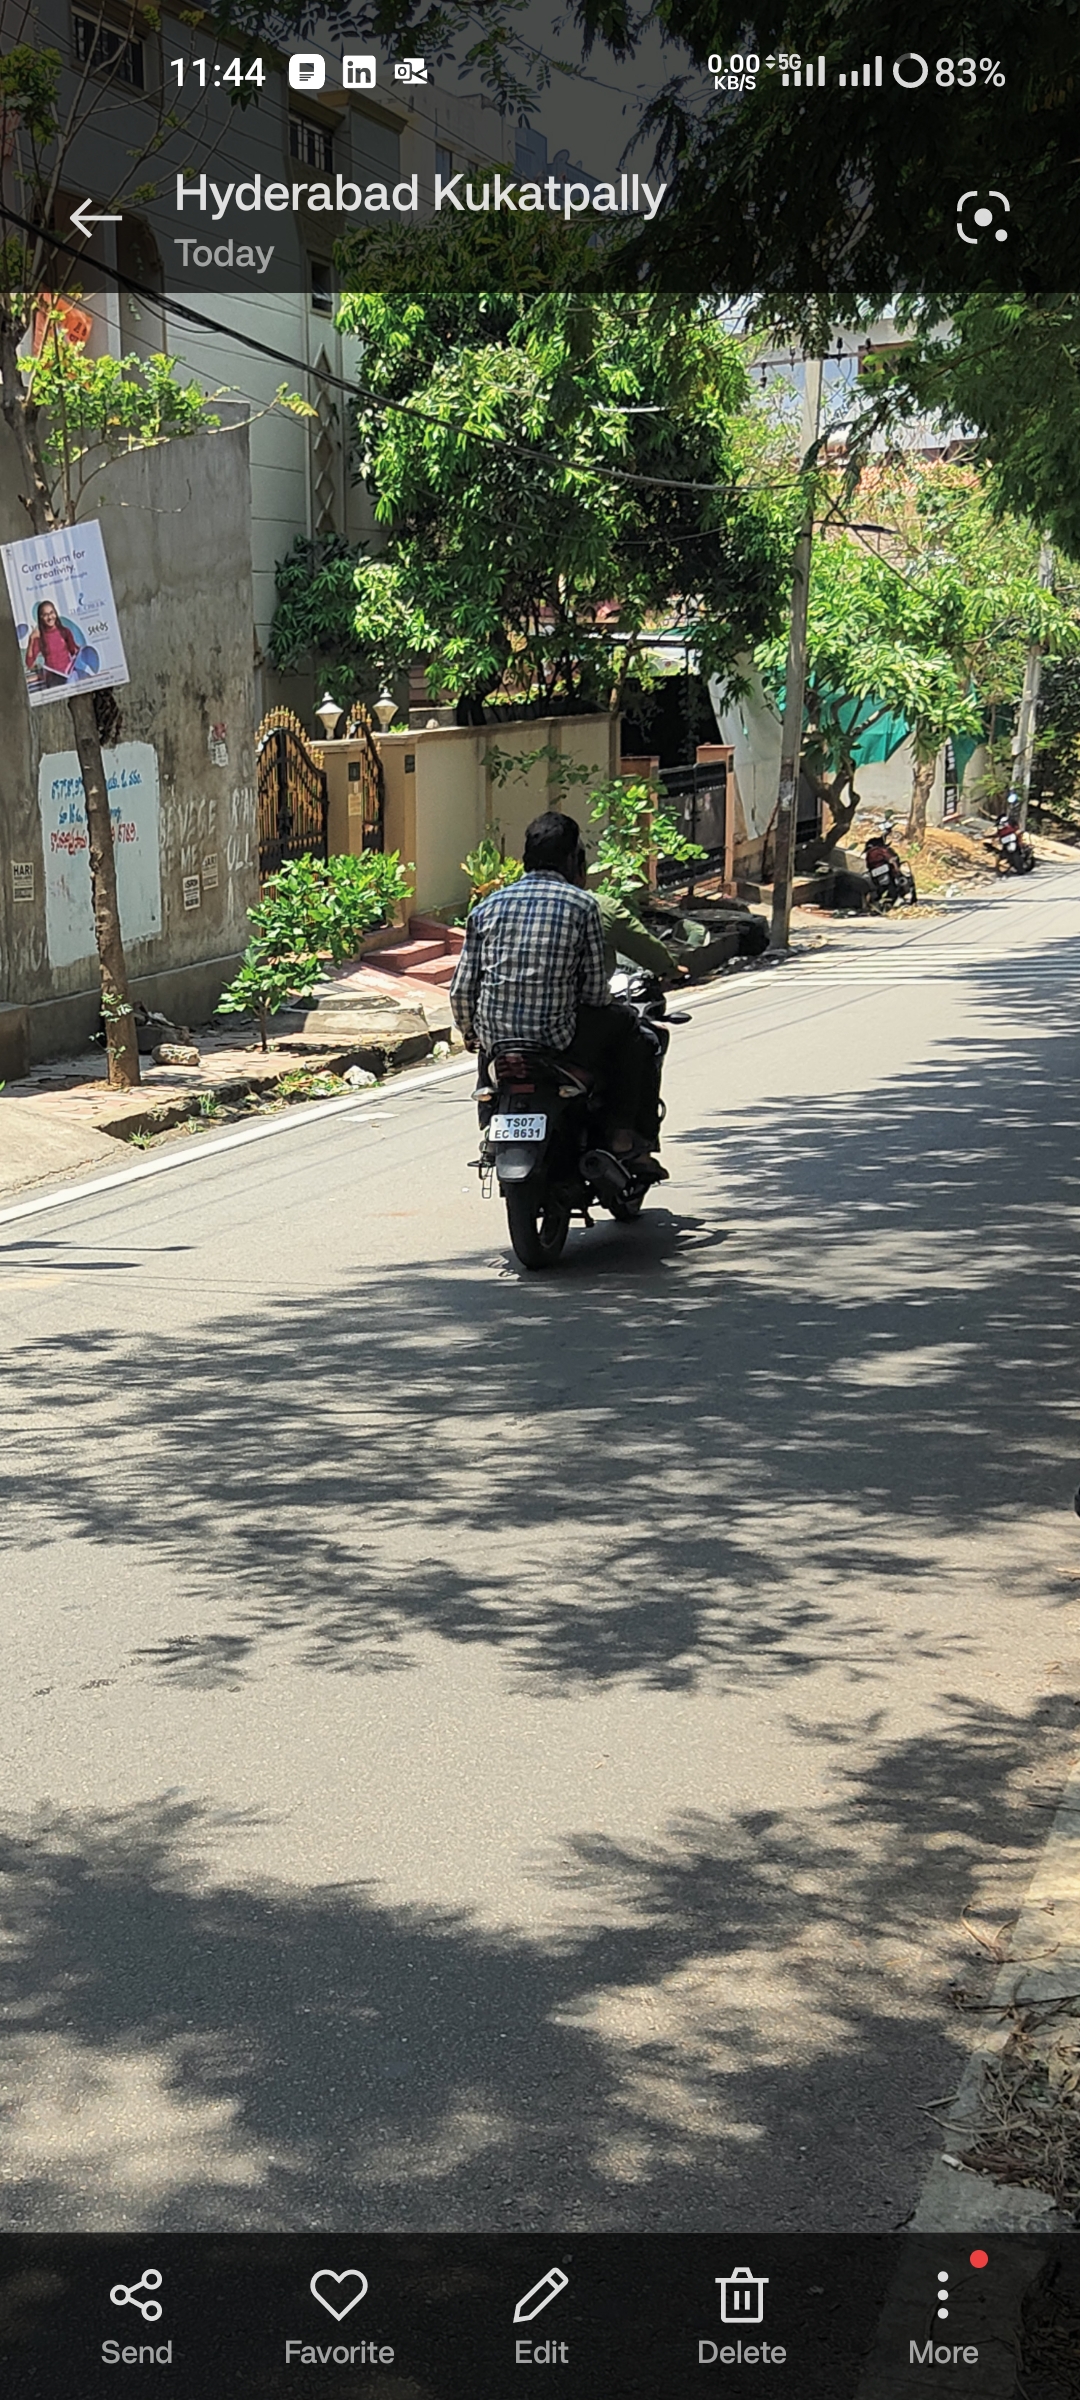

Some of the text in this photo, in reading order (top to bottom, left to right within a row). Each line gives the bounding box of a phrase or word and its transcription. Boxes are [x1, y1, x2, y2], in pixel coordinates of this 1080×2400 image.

[21, 550, 86, 574] Curriculum for
[13, 865, 33, 876] HARI
[506, 1117, 535, 1128] TS07
[494, 1128, 541, 1139] EC 8631
